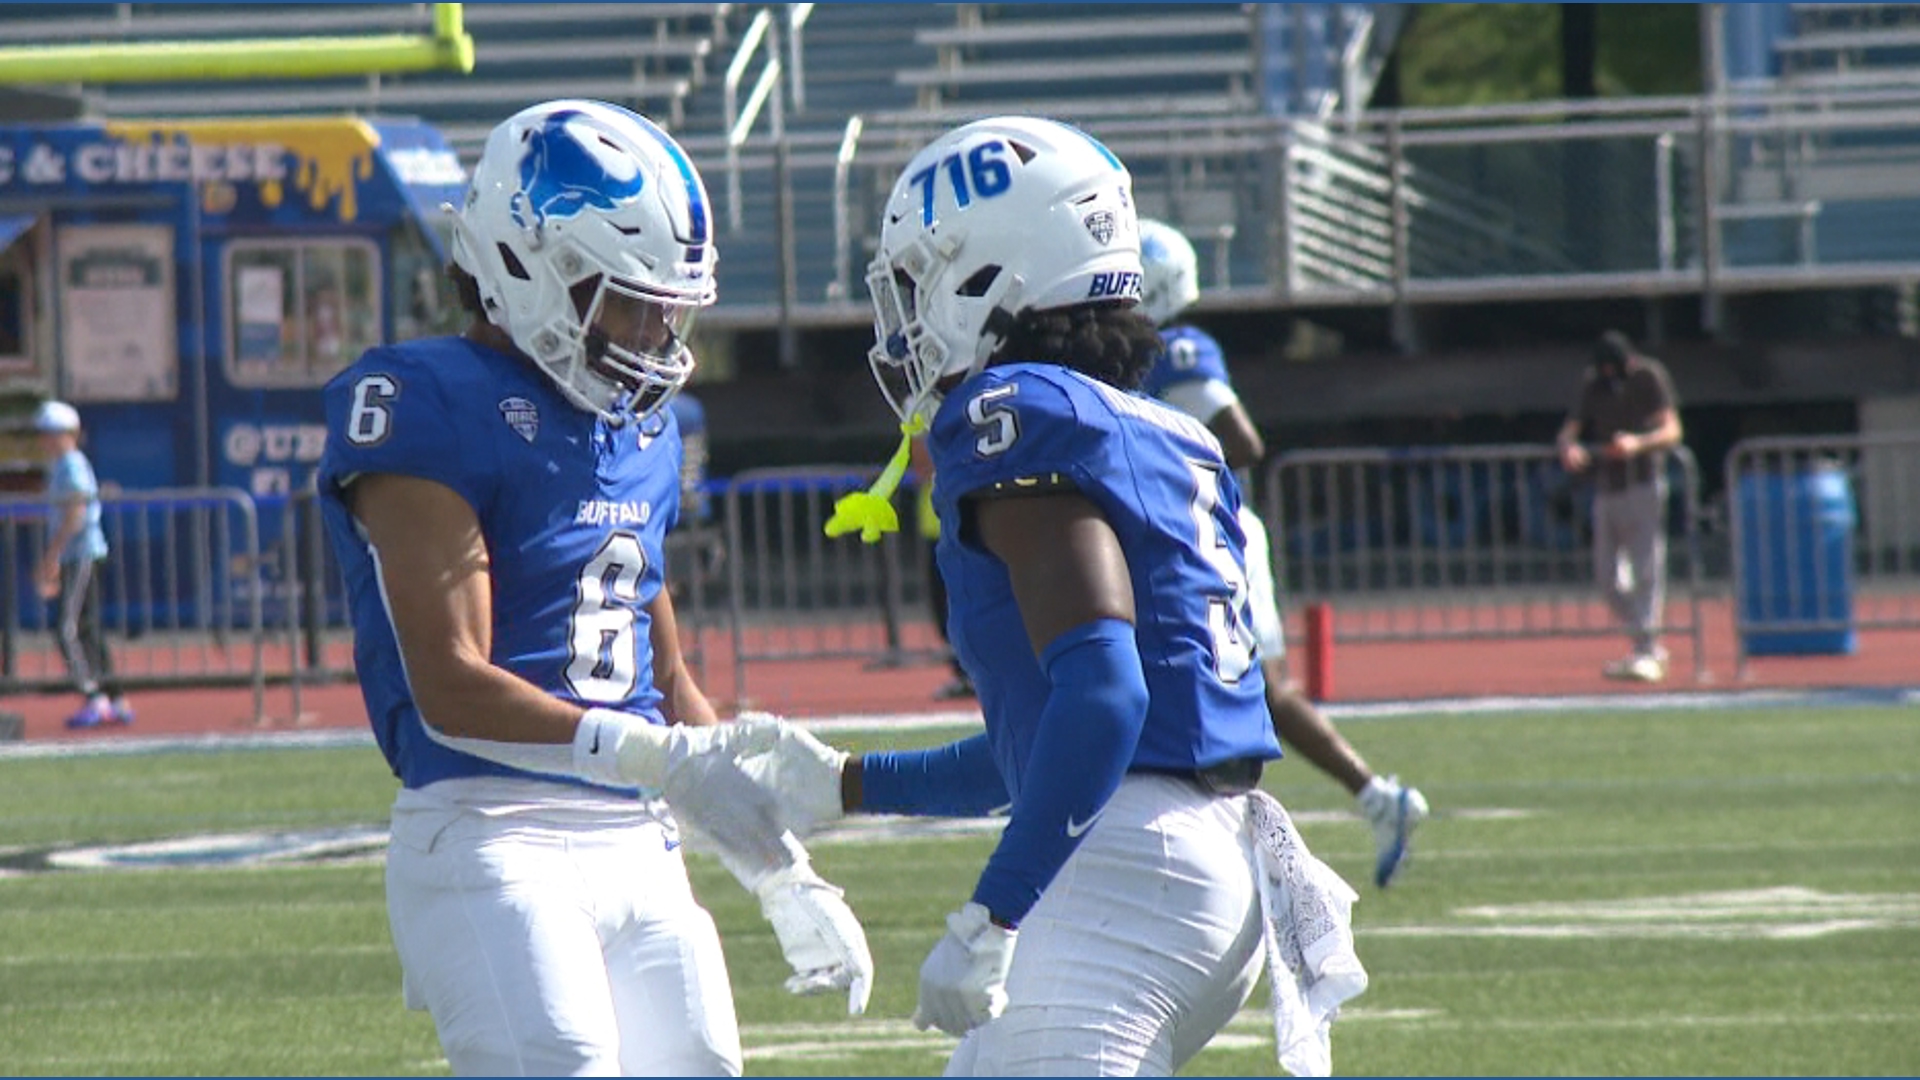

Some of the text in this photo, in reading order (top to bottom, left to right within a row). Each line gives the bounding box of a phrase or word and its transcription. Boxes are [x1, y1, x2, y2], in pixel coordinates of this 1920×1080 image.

[76, 145, 288, 182] CHEESE
[909, 140, 1012, 228] 716
[345, 373, 398, 447] 6
[966, 382, 1019, 457] 5
[573, 499, 650, 526] BUFFALO
[562, 530, 648, 704] 6
